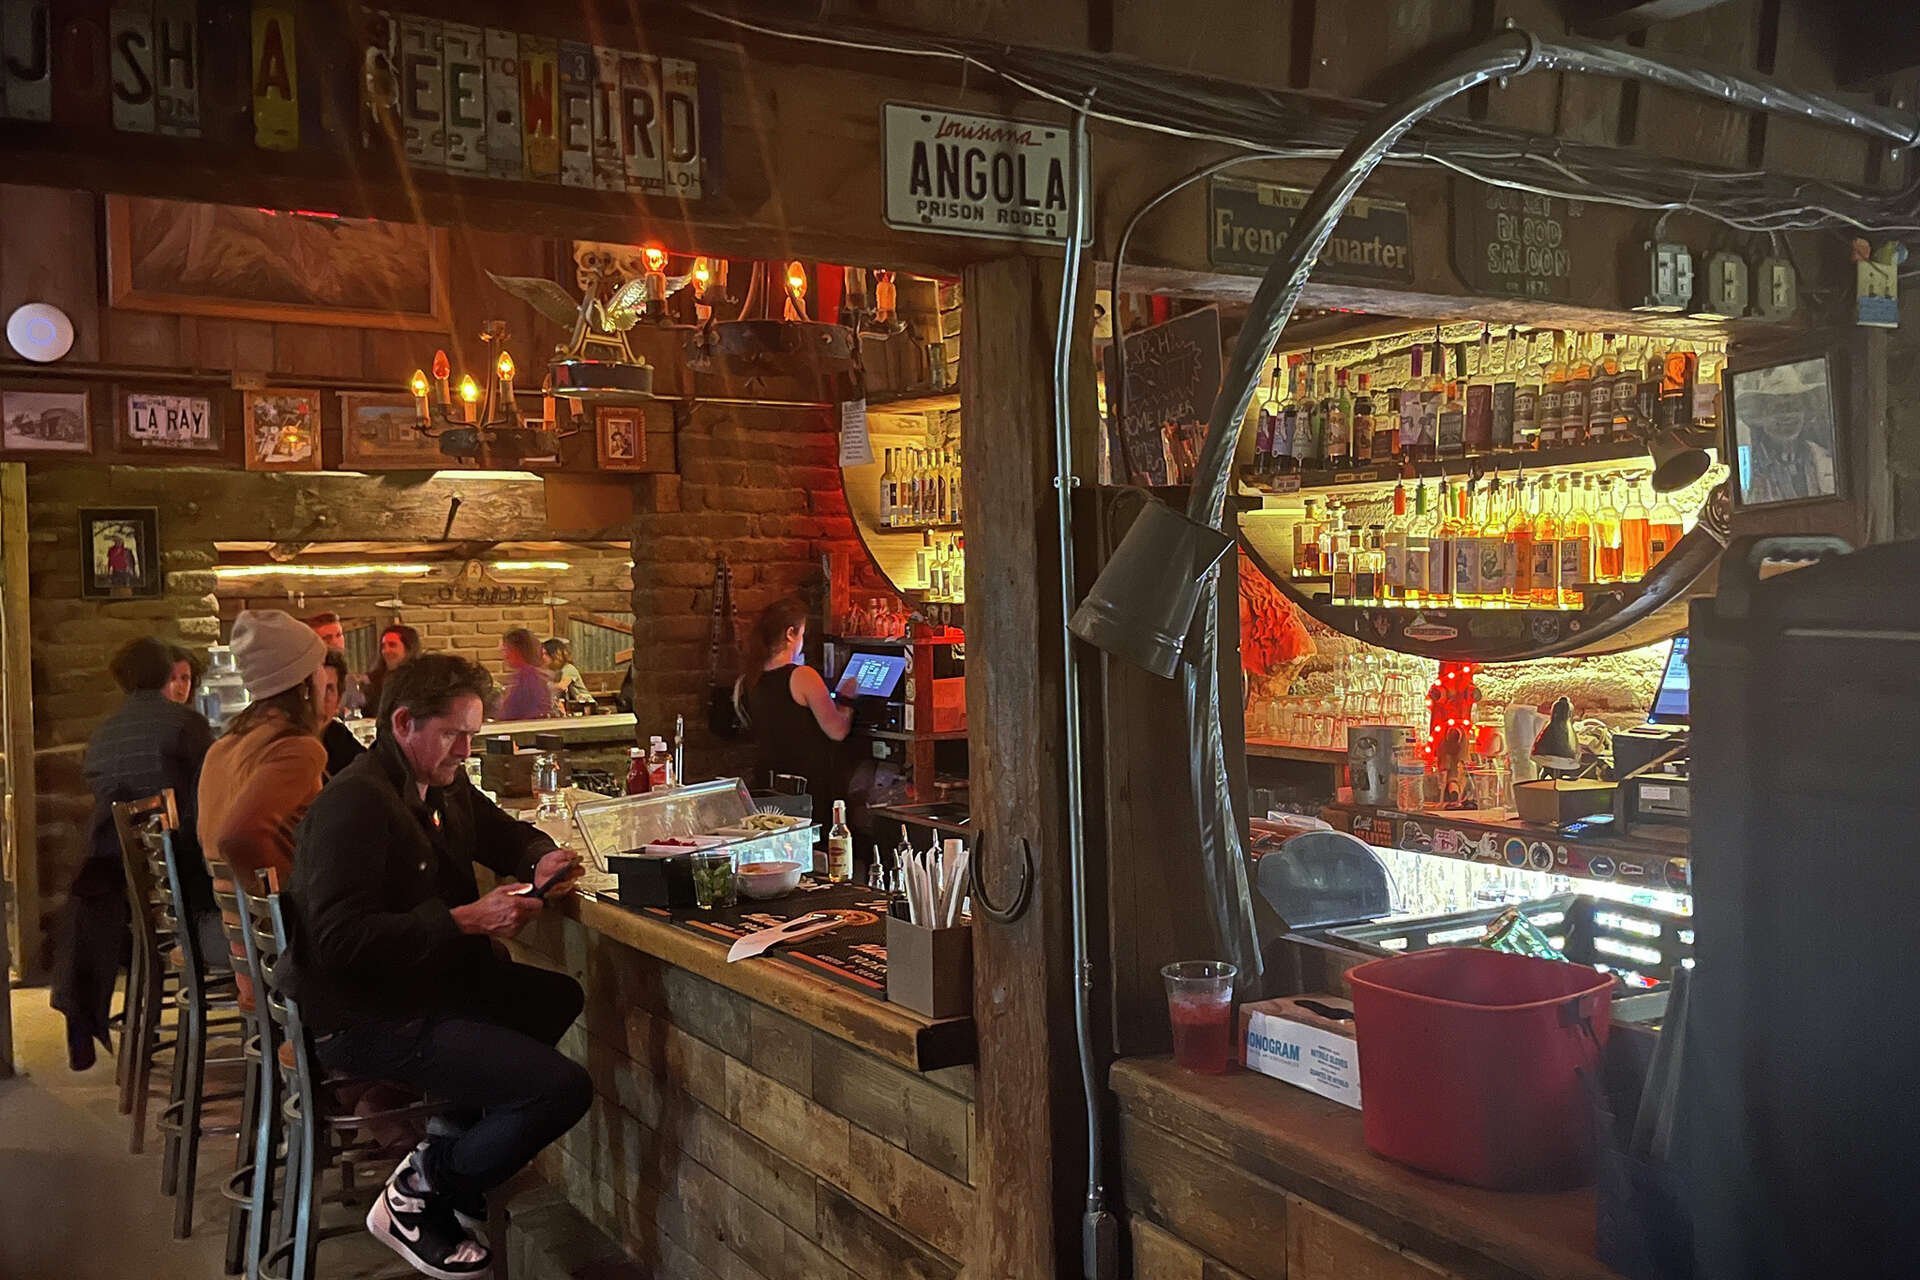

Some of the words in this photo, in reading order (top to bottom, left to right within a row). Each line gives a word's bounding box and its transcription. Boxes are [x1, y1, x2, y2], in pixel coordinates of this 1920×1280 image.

[935, 115, 1042, 146] Louisiana
[910, 141, 1067, 211] ANGOLA
[917, 200, 984, 222] PRISON
[997, 208, 1056, 228] RODEO
[1215, 207, 1296, 255] Frenc
[1497, 213, 1562, 248] BLOOD
[1488, 243, 1571, 277] SALOON
[135, 407, 158, 432] LA
[167, 408, 203, 434] RAY
[1247, 1030, 1300, 1061] ONOGRAM
